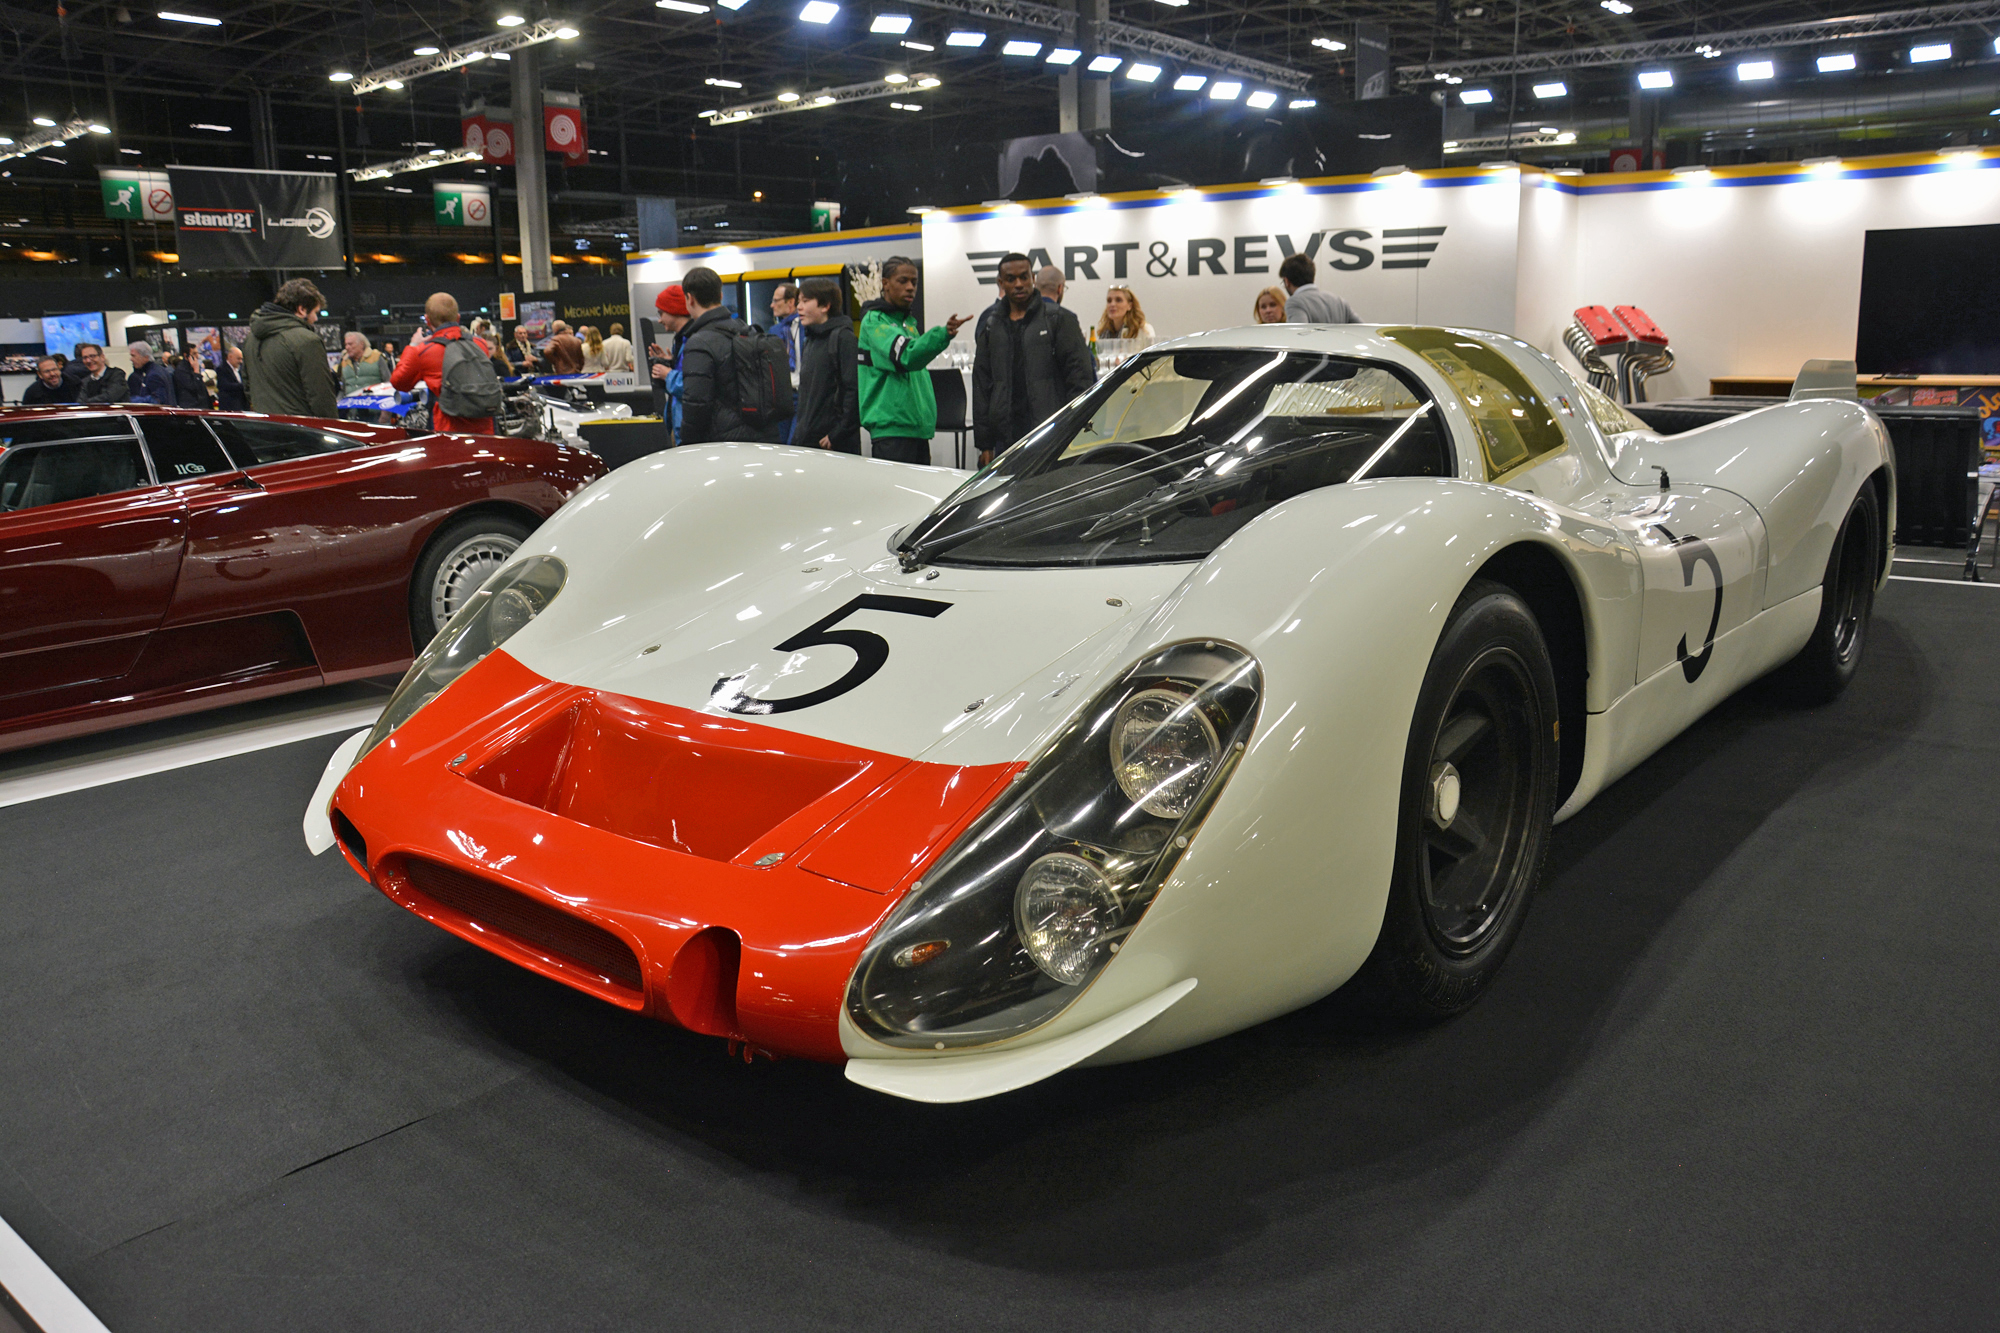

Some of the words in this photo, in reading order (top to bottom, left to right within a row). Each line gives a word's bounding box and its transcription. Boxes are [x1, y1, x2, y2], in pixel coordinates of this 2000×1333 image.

[184, 211, 252, 228] stand21
[564, 306, 601, 319] MECHANIC
[606, 378, 625, 386] Mobil
[710, 593, 955, 716] 5
